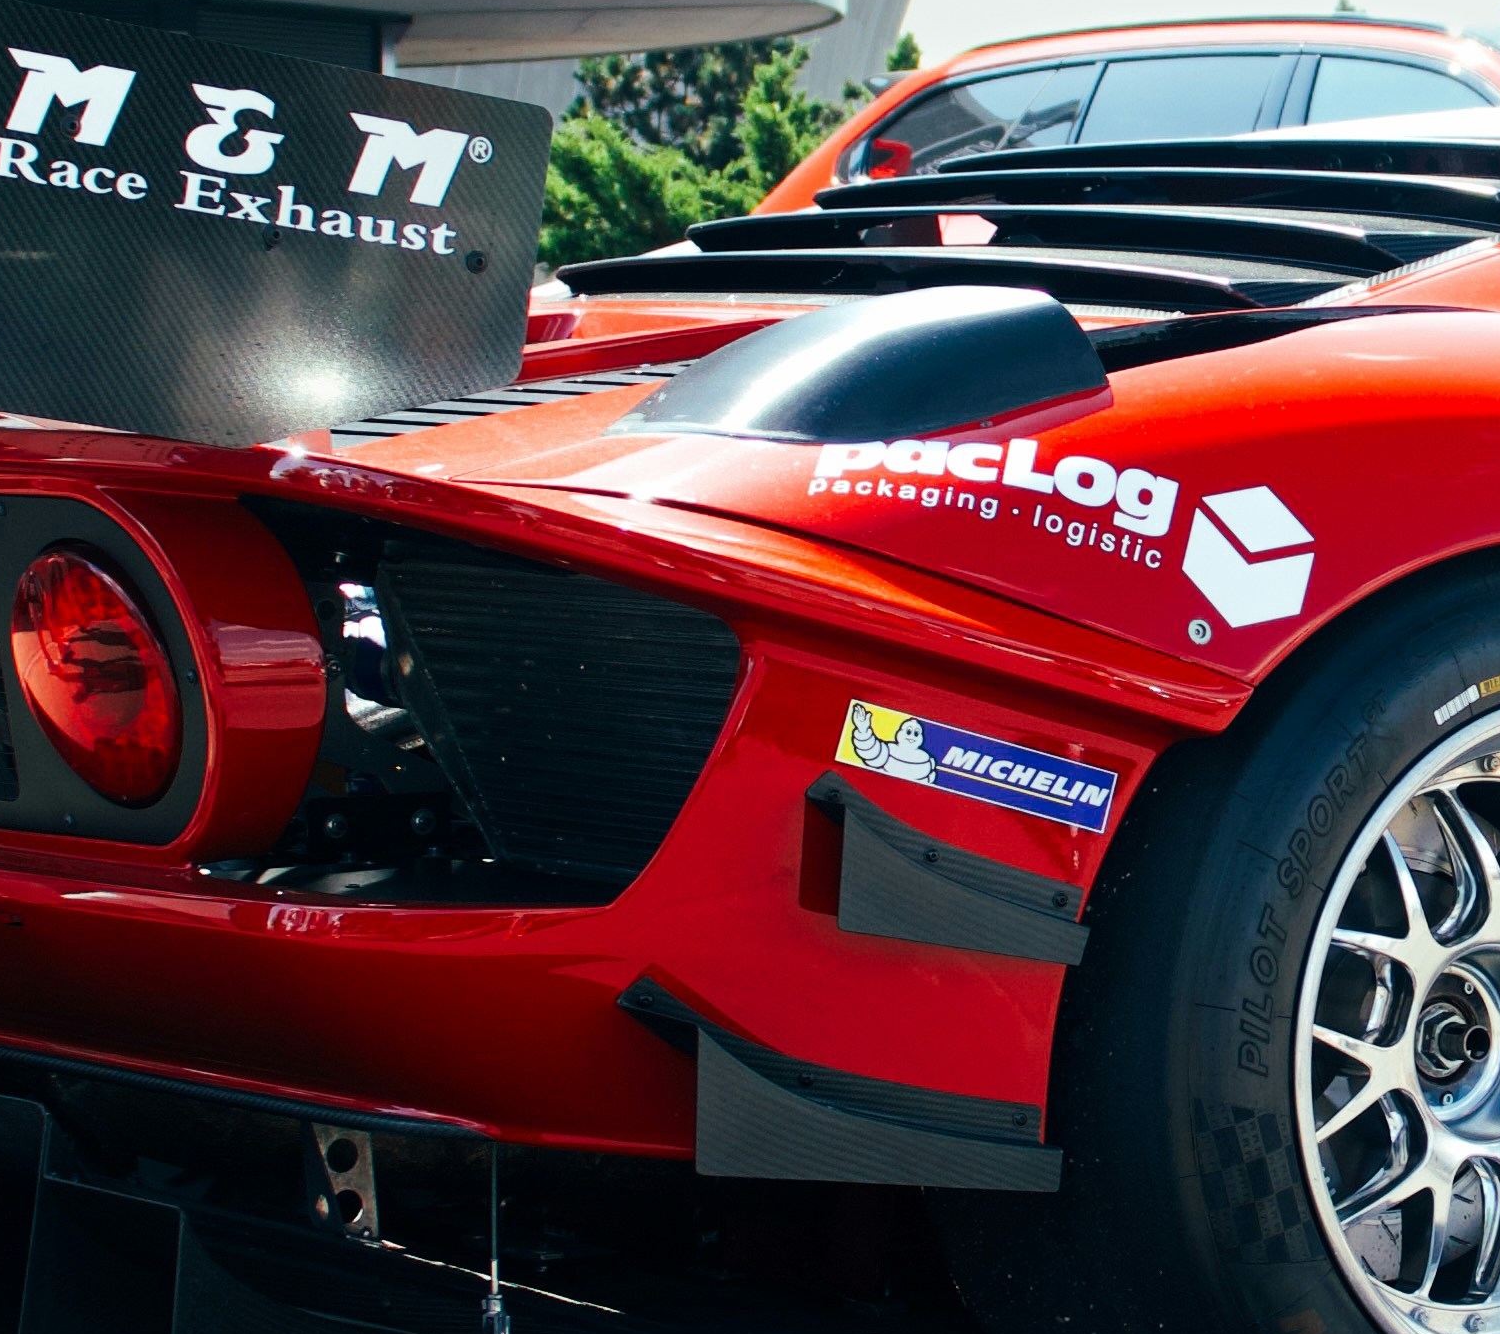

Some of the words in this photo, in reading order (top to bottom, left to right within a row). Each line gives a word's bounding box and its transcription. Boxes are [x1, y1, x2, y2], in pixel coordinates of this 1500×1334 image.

[6, 47, 137, 147] M
[185, 83, 285, 175] &
[174, 171, 458, 256] Exhaust
[808, 476, 1000, 520] packaging
[1032, 503, 1163, 569] logistic
[941, 744, 1111, 809] MICHELIN
[1237, 901, 1289, 1078] PILOT
[1276, 730, 1368, 900] SPORT
